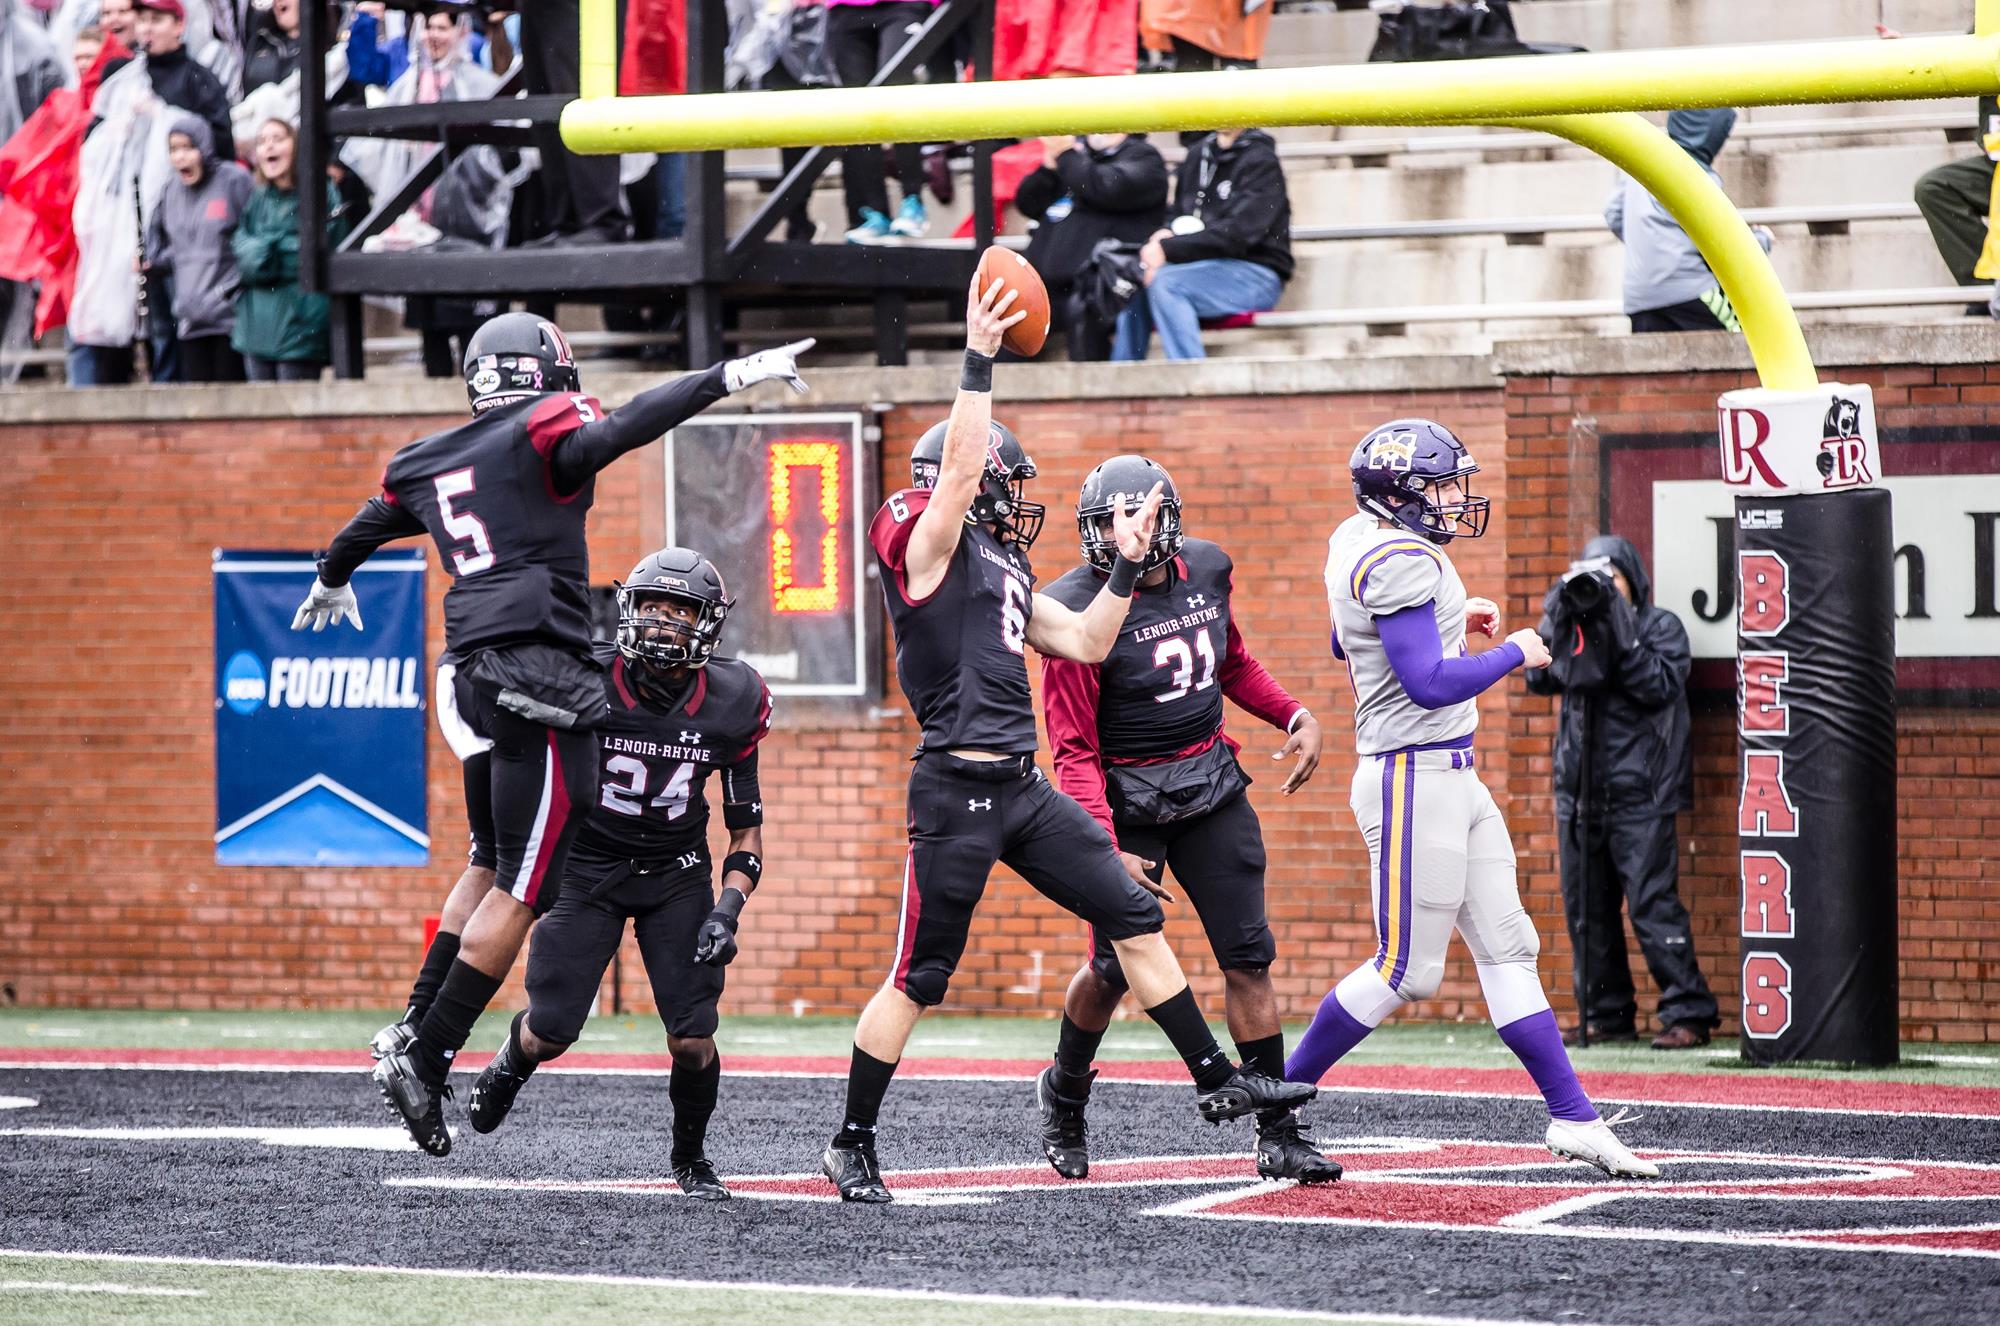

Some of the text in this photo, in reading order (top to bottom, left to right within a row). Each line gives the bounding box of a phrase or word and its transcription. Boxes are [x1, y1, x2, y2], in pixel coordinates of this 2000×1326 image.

[569, 395, 597, 423] 5
[432, 465, 497, 577] 5
[770, 442, 839, 612] 0
[887, 492, 911, 524] 6
[1739, 508, 1784, 525] UCS
[1001, 572, 1026, 657] 6
[1134, 605, 1219, 644] LENOIR-RHYNE
[268, 656, 420, 709] FOOTBALL
[1151, 626, 1216, 704] 31
[604, 736, 711, 762] LENOIR-RHYNE
[600, 754, 696, 822] 24
[1738, 549, 1800, 1040] BEARS
